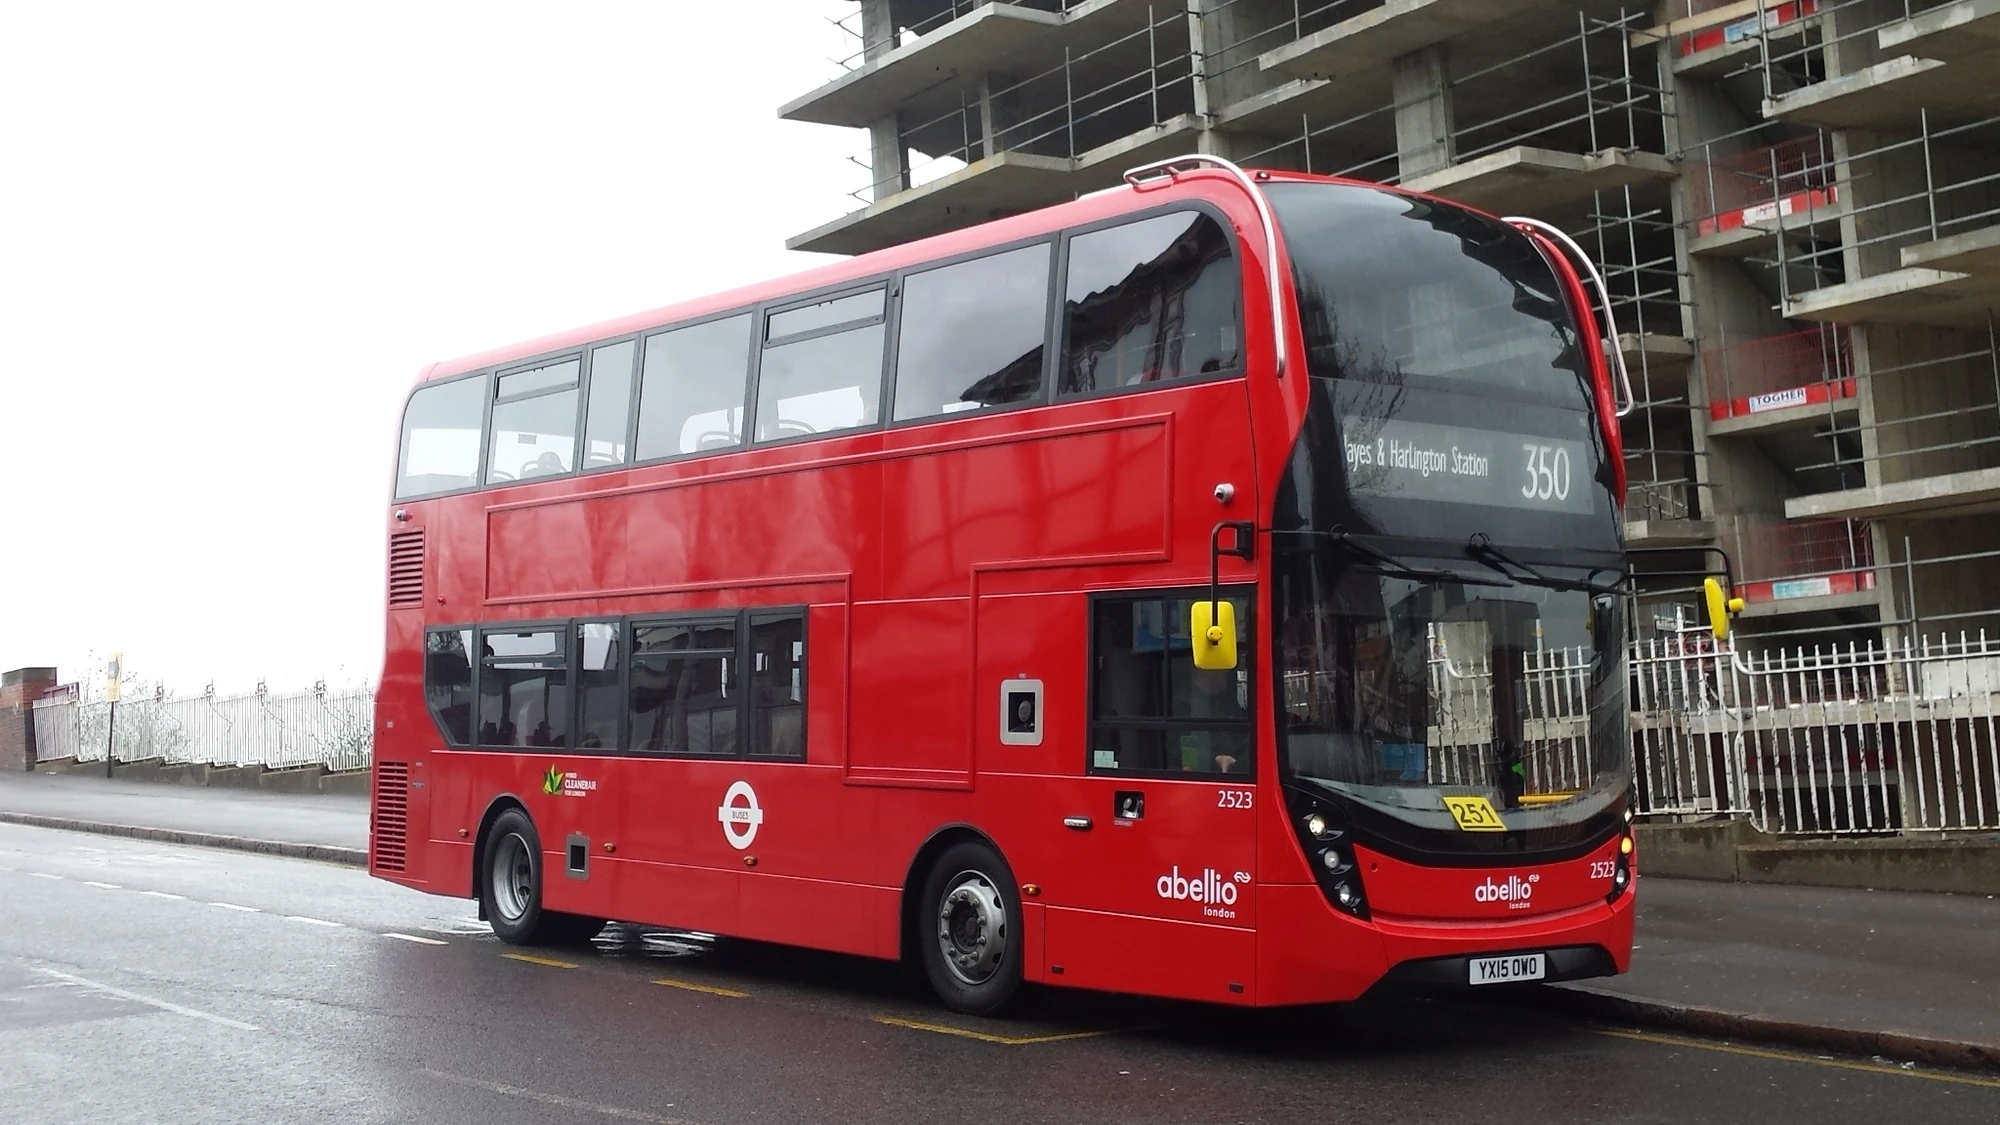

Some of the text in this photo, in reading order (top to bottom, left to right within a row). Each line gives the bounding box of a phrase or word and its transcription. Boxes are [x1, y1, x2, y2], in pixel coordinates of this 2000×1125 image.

[1757, 389, 1804, 404] TOGHER
[1377, 437, 1385, 466] &
[1390, 439, 1447, 478] Harlington
[1451, 446, 1488, 477] Station
[1521, 444, 1571, 501] 350
[1217, 790, 1253, 809] 2523
[732, 811, 748, 819] BUSES
[1452, 803, 1496, 824] 251
[1590, 861, 1615, 879] 2523
[1157, 865, 1238, 905] abellio
[1475, 876, 1532, 902] abellio
[1204, 906, 1236, 919] london
[1479, 959, 1537, 979] YX15 OWO
